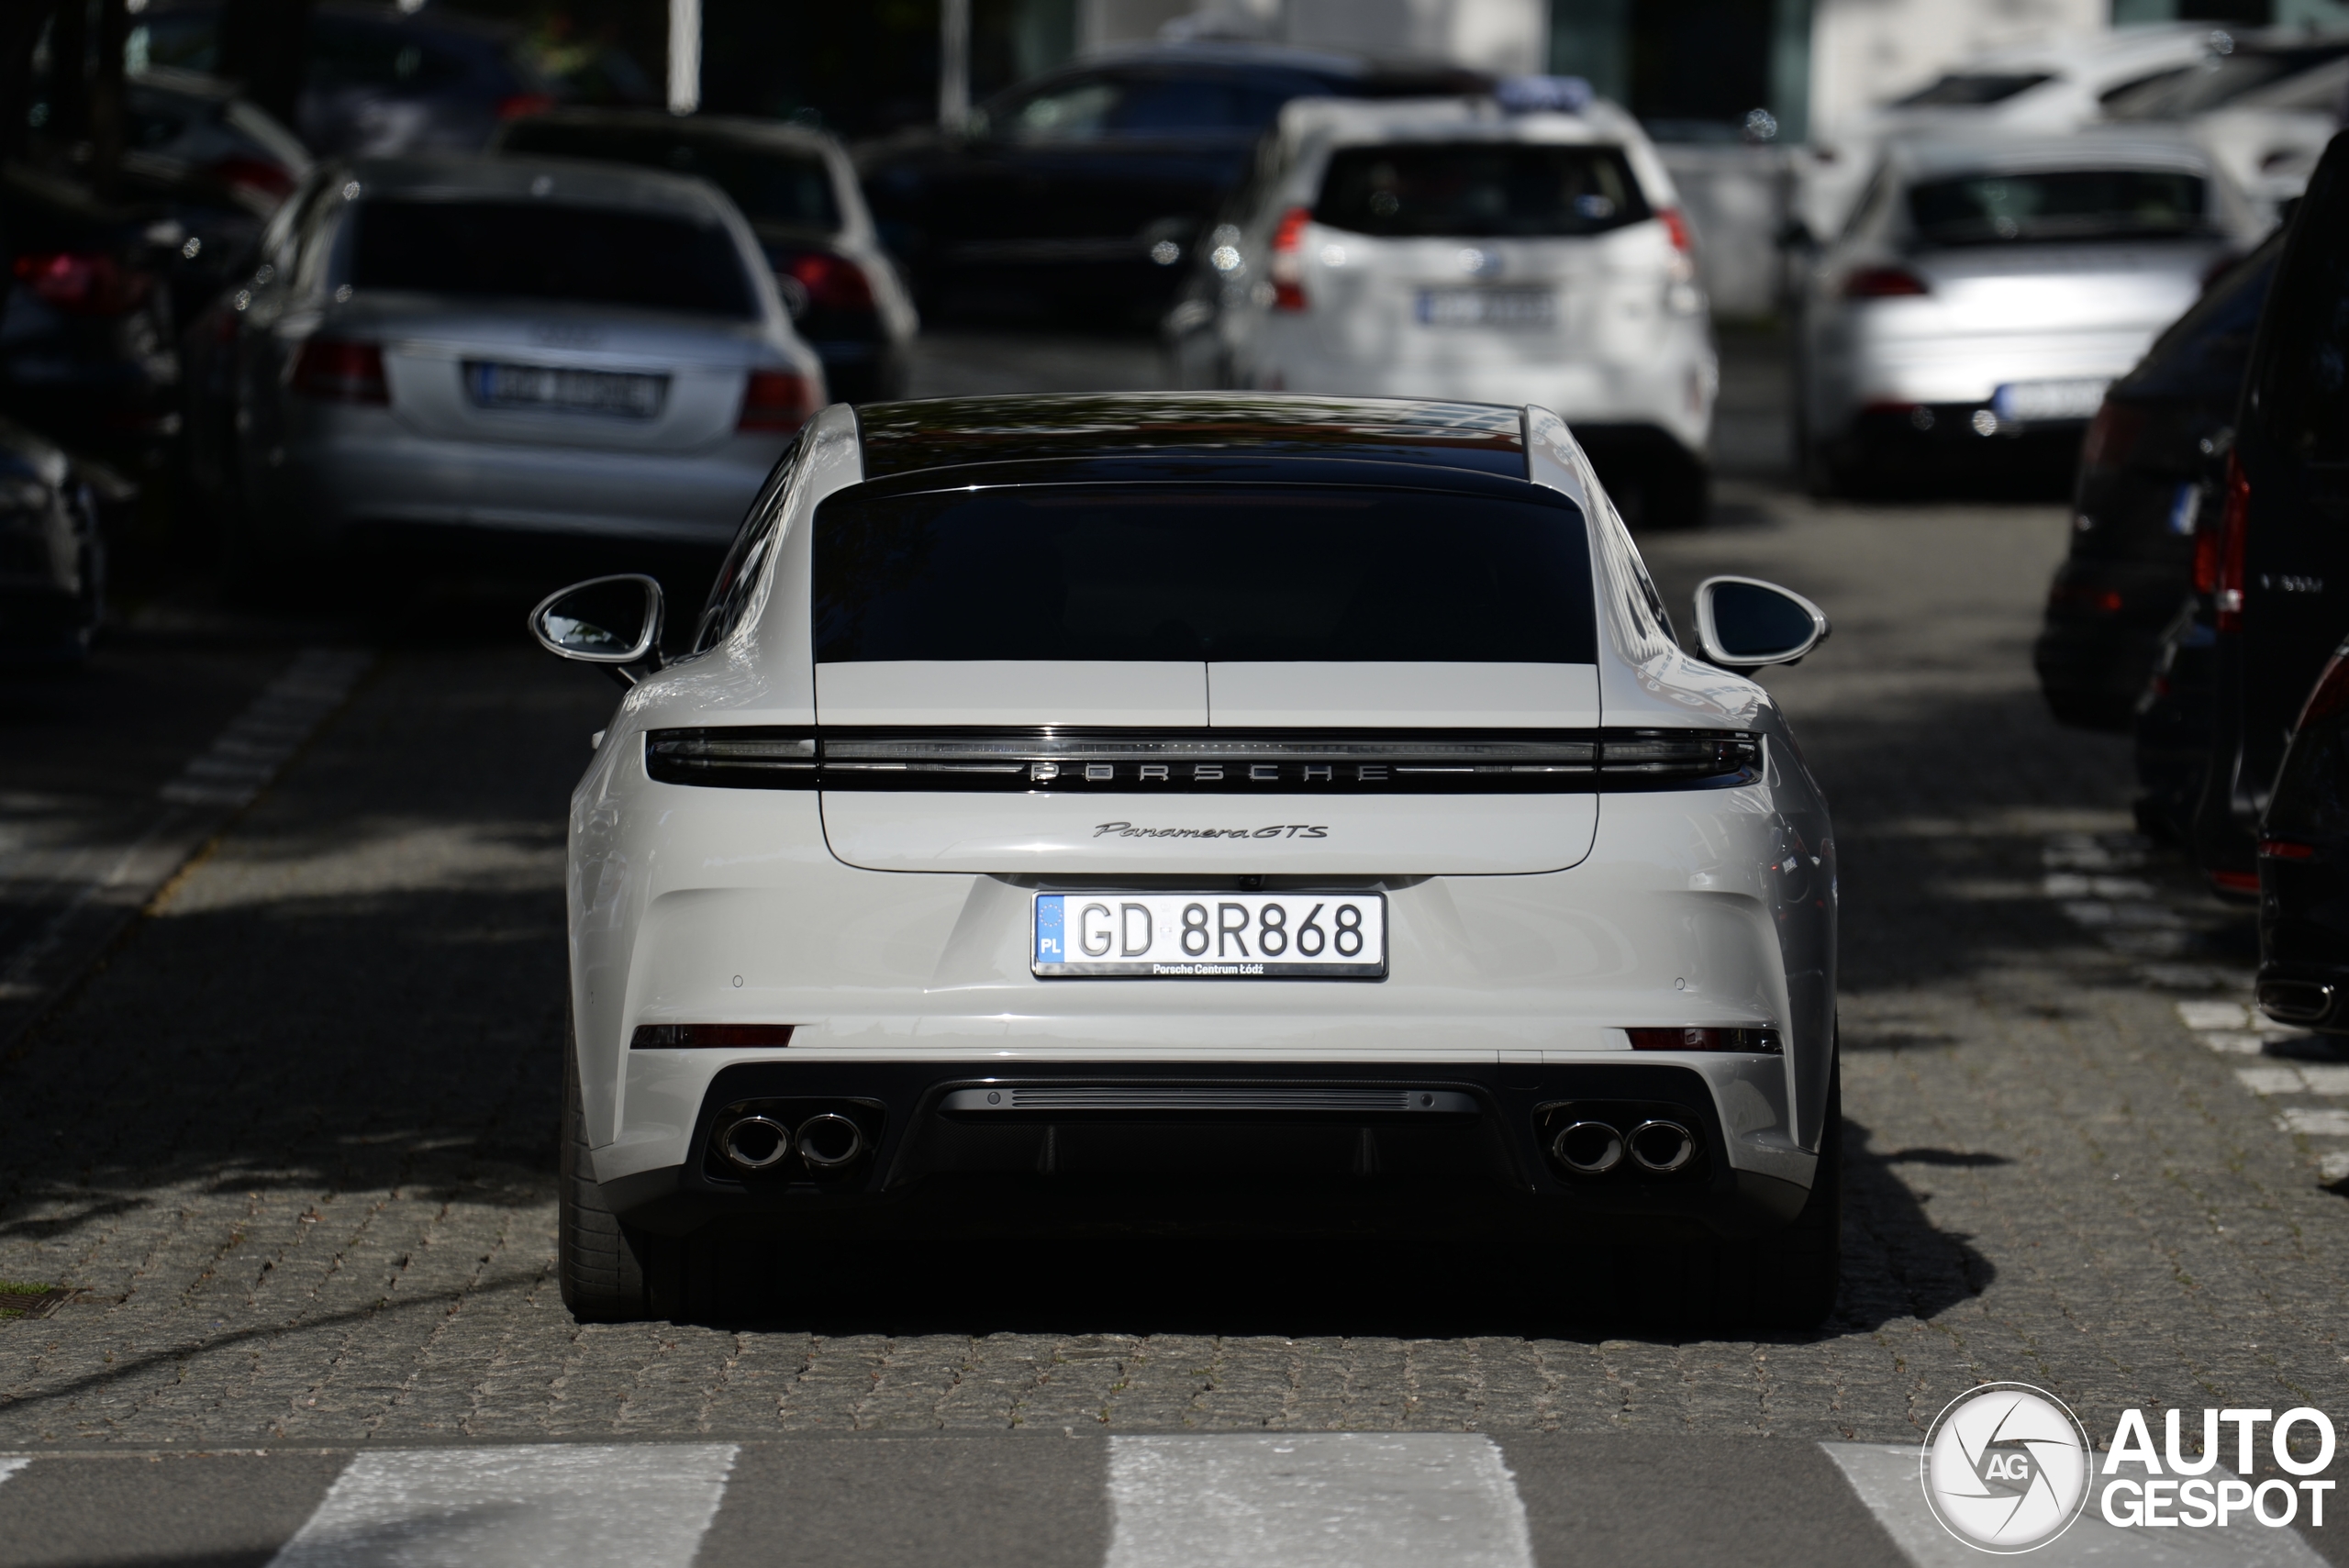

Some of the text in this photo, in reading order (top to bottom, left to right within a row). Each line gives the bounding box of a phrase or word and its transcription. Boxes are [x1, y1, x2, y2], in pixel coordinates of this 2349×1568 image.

[1030, 763, 1389, 782] PORSCHE
[1077, 902, 1364, 957] GD 8R868
[1041, 938, 1062, 954] PL
[1152, 963, 1264, 974] Porsche Centrum Łódź
